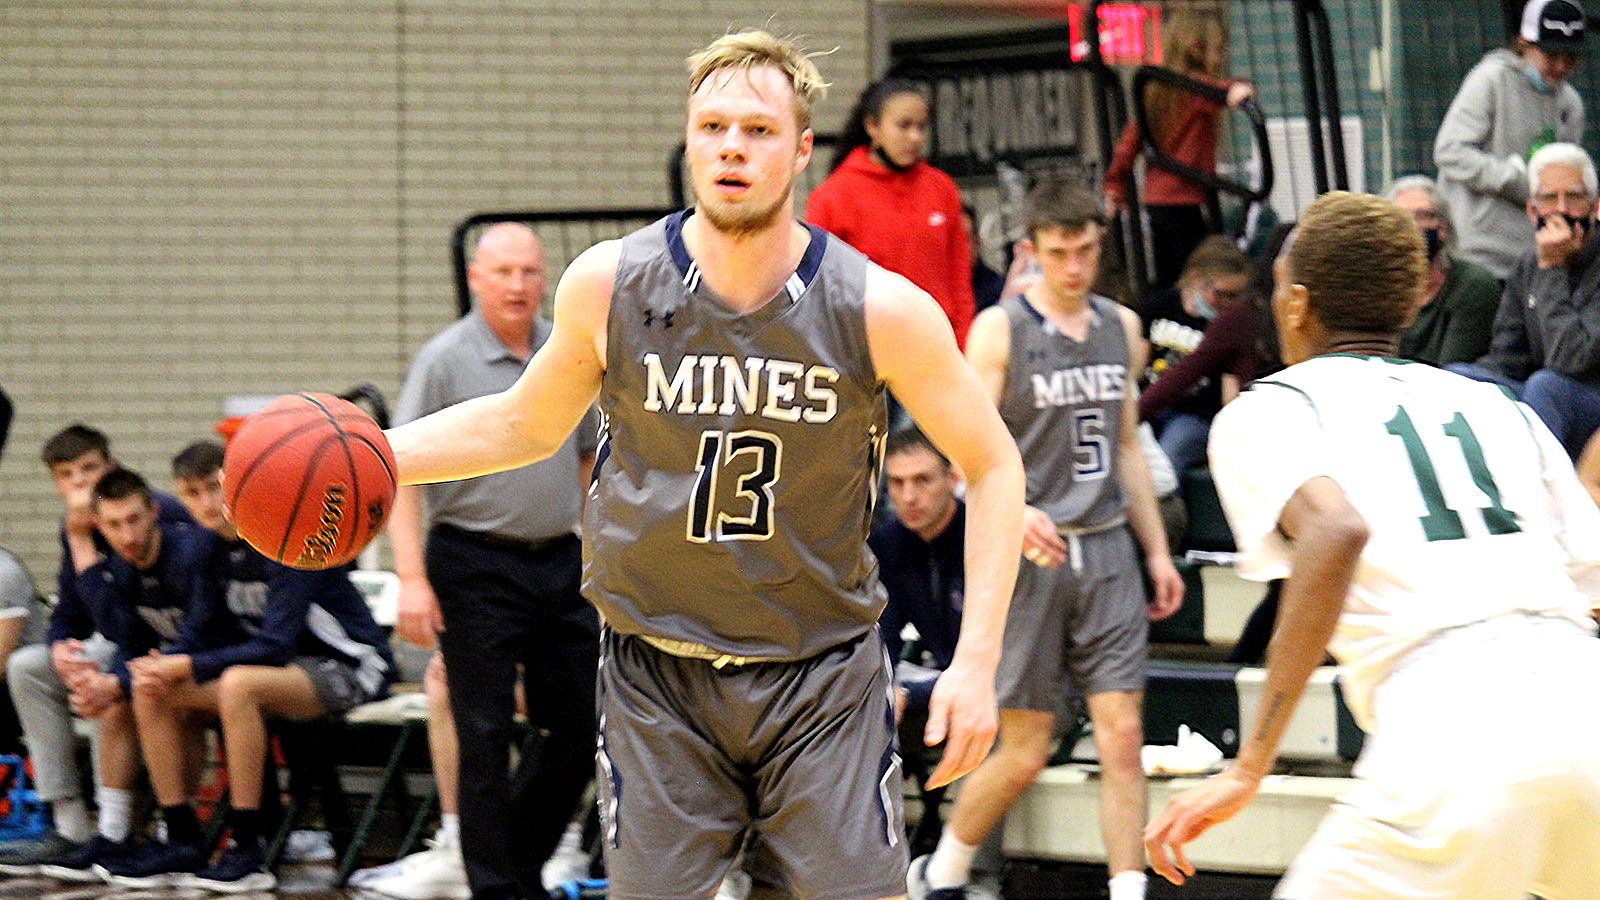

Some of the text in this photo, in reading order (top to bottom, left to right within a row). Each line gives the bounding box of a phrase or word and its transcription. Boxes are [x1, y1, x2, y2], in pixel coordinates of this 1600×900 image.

[642, 352, 840, 424] MINES
[1031, 364, 1126, 409] MINES
[1071, 407, 1110, 481] 5
[1383, 404, 1523, 542] 11
[686, 429, 783, 543] 13
